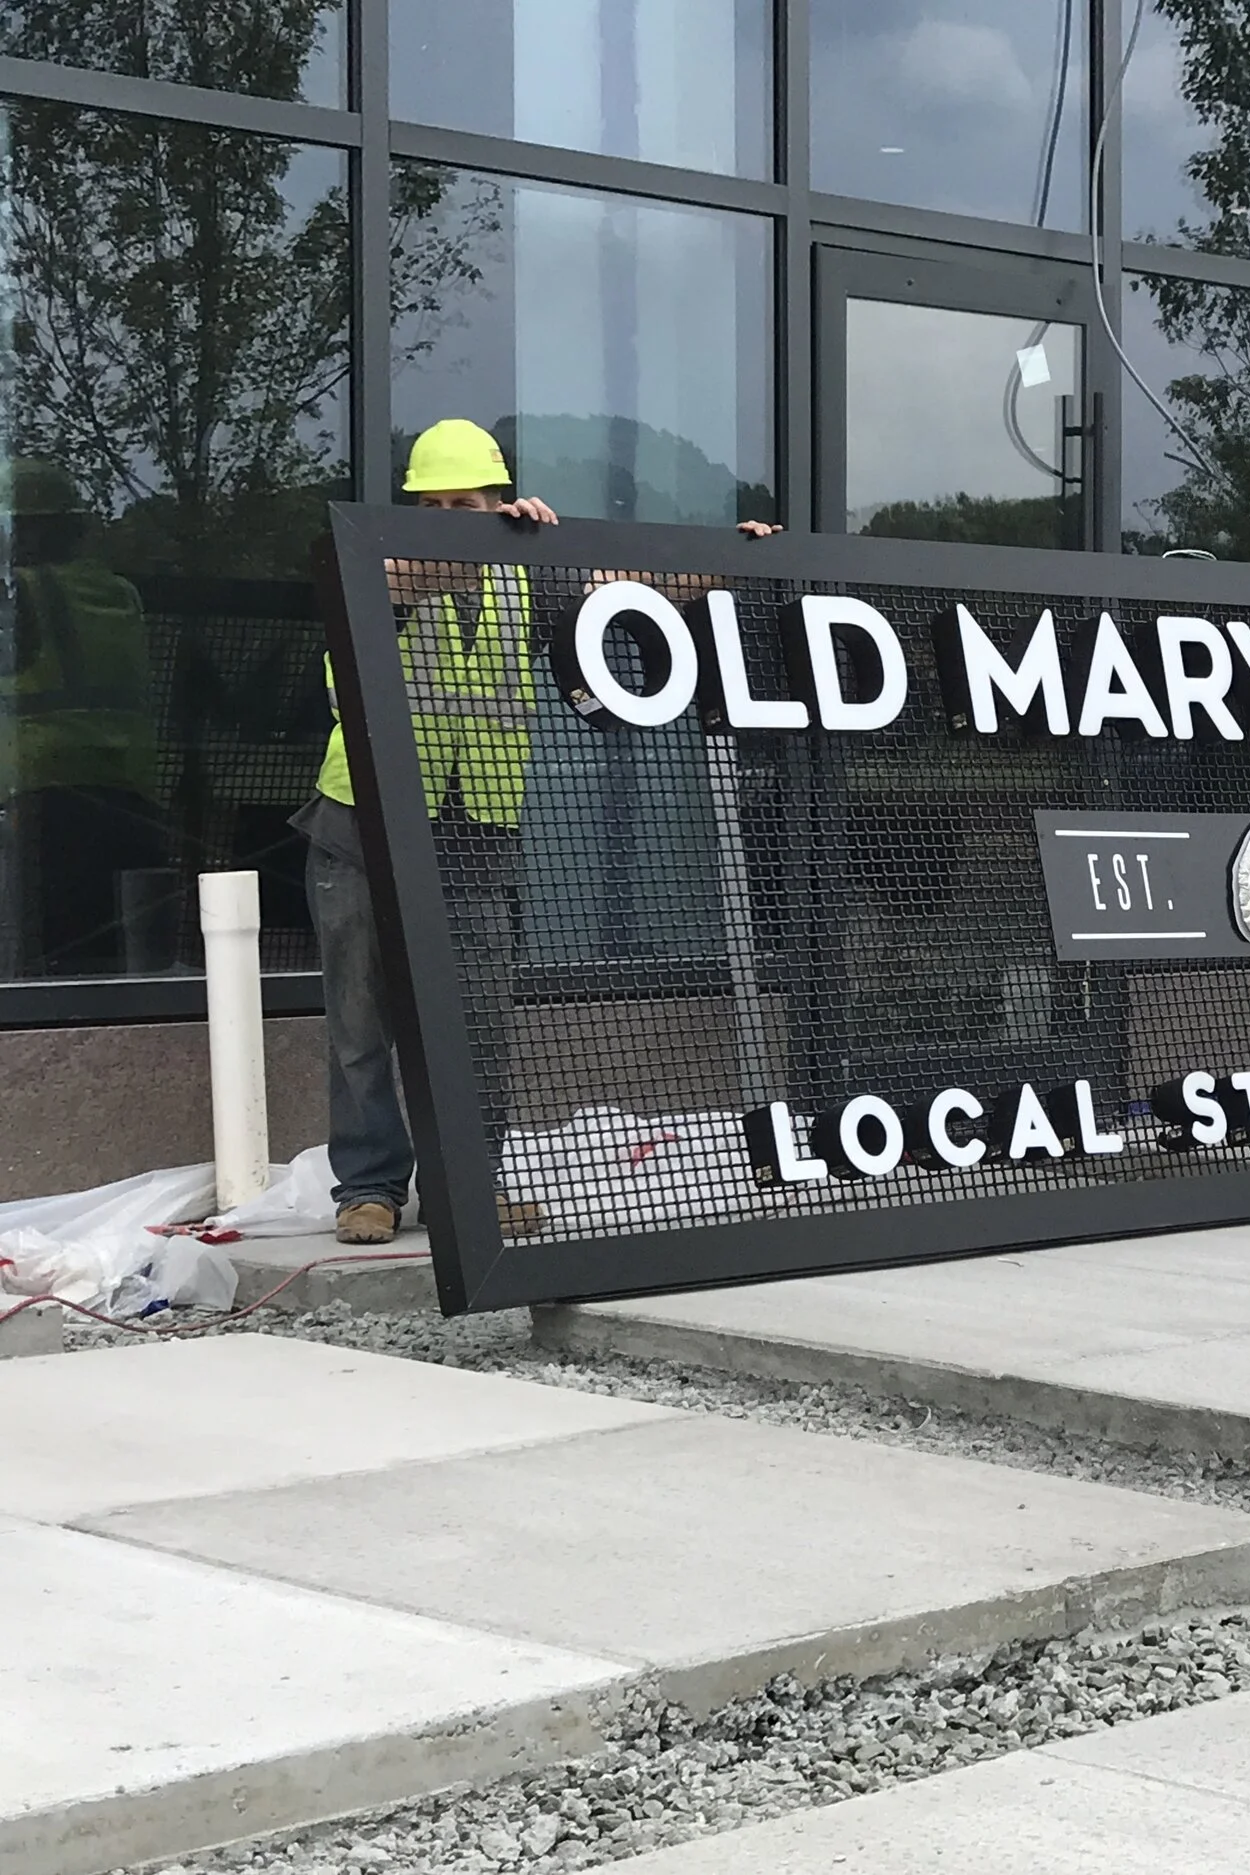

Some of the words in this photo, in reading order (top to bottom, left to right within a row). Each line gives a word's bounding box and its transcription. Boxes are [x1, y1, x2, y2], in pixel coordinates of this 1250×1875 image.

[574, 580, 907, 729] OLD
[1087, 853, 1174, 911] EST.
[770, 1079, 1124, 1182] LOCAL
